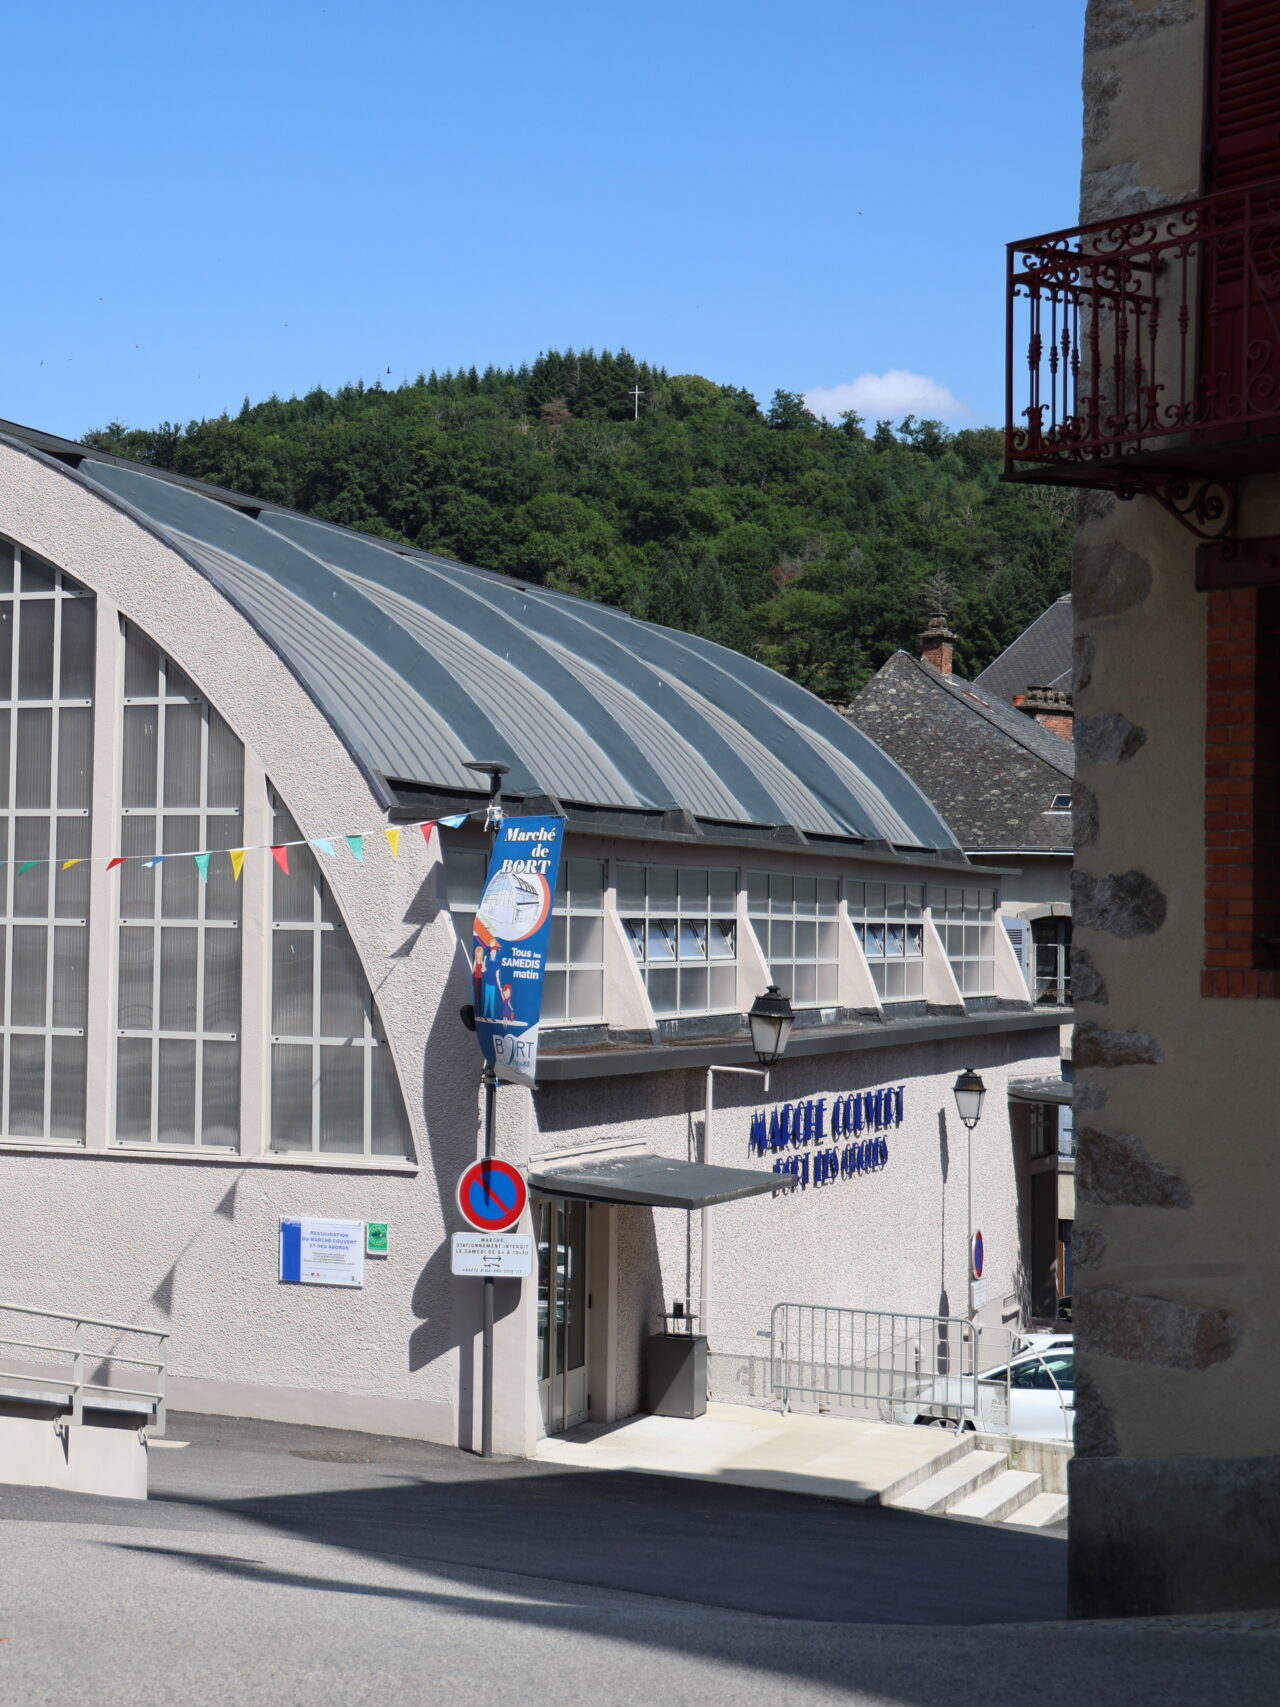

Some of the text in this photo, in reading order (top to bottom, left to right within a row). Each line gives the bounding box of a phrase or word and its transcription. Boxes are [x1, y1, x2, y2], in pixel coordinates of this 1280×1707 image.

[504, 827, 556, 842] Marché
[531, 843, 549, 858] de
[501, 859, 551, 875] BORT
[512, 947, 532, 958] Tous
[501, 957, 541, 969] SAMEDIS
[513, 970, 539, 980] matin
[495, 1036, 534, 1061] BORT
